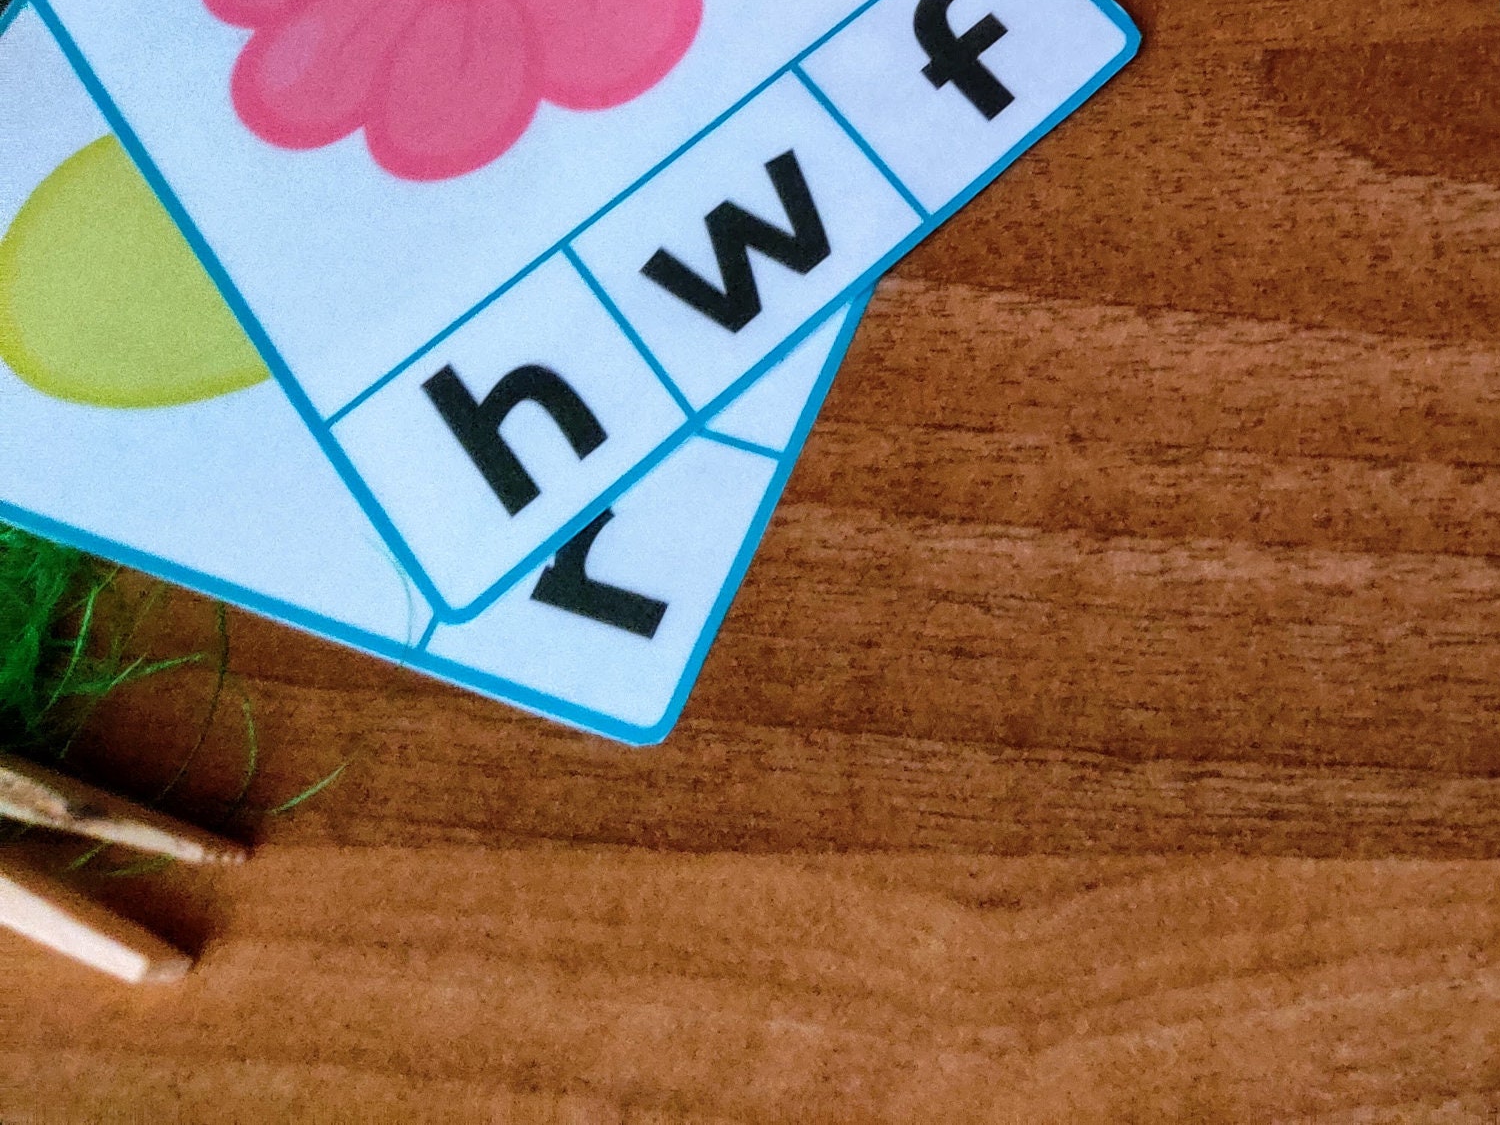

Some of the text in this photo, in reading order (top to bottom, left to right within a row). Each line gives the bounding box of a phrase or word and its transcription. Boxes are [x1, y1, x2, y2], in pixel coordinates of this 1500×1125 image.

[421, 364, 608, 516] h
[640, 149, 832, 334] w
[530, 506, 669, 639] r
